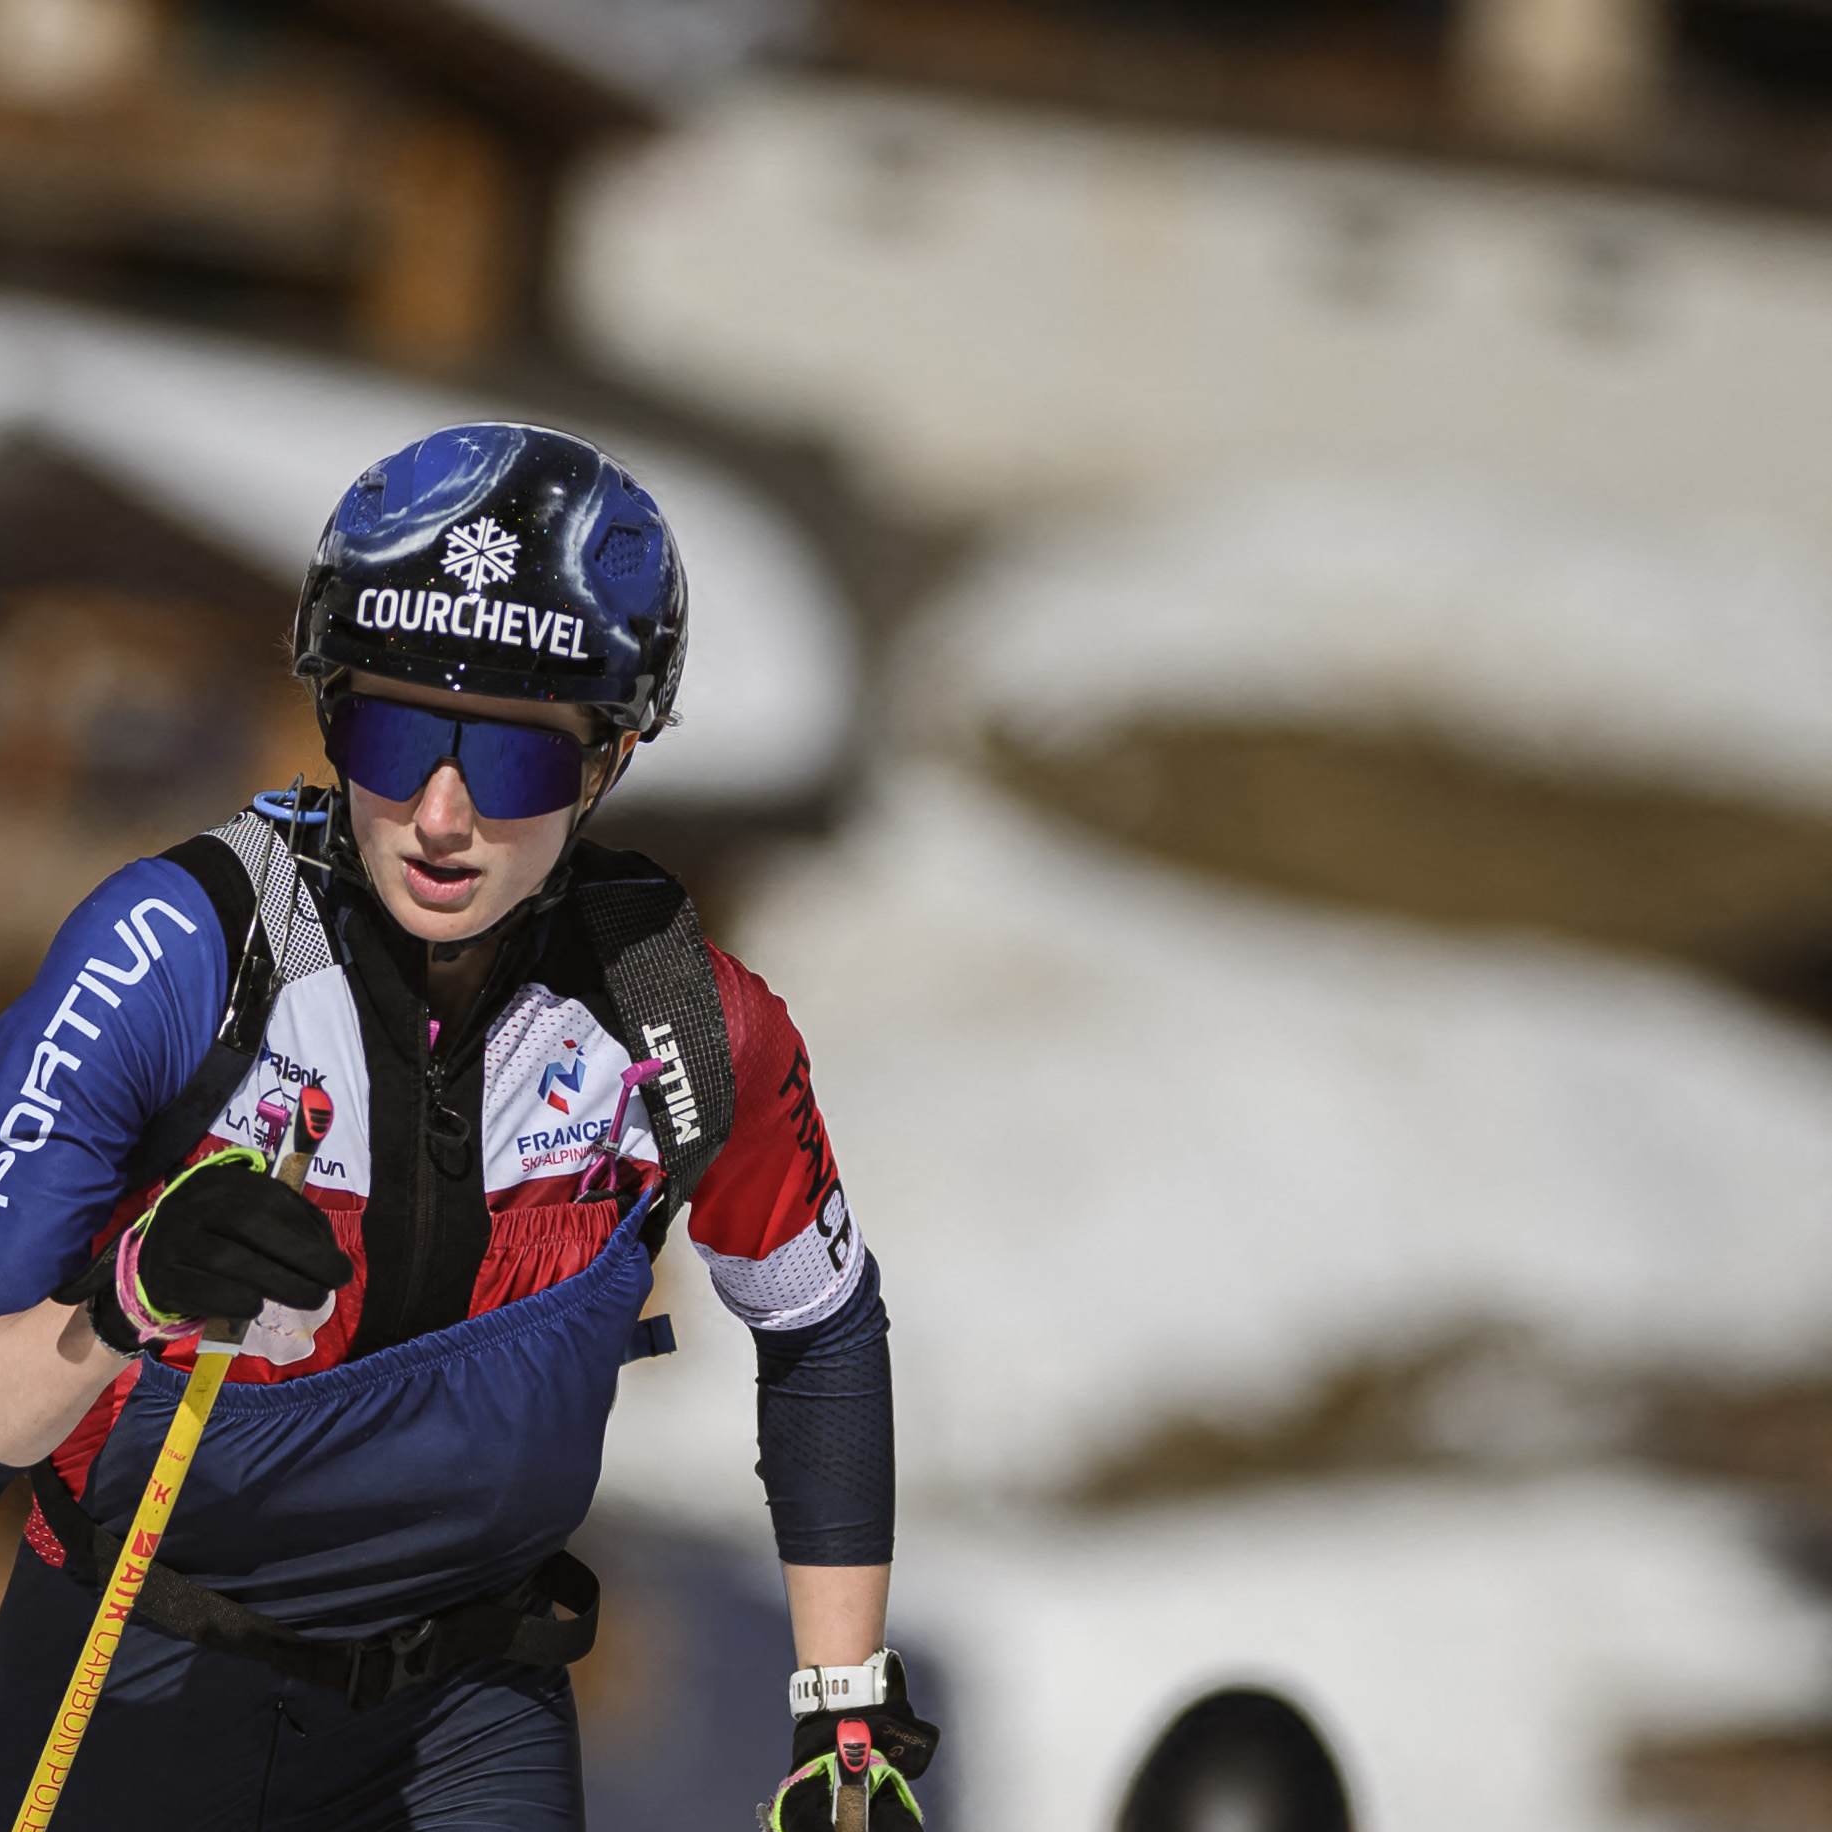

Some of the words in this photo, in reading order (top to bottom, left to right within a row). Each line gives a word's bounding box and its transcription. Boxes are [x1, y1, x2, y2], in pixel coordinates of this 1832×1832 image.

[356, 588, 589, 659] COURCHEVEL
[641, 1023, 702, 1147] MILLET
[225, 1108, 251, 1136] LA
[516, 1118, 613, 1155] FRANCE
[52, 1630, 121, 1756] CARBON
